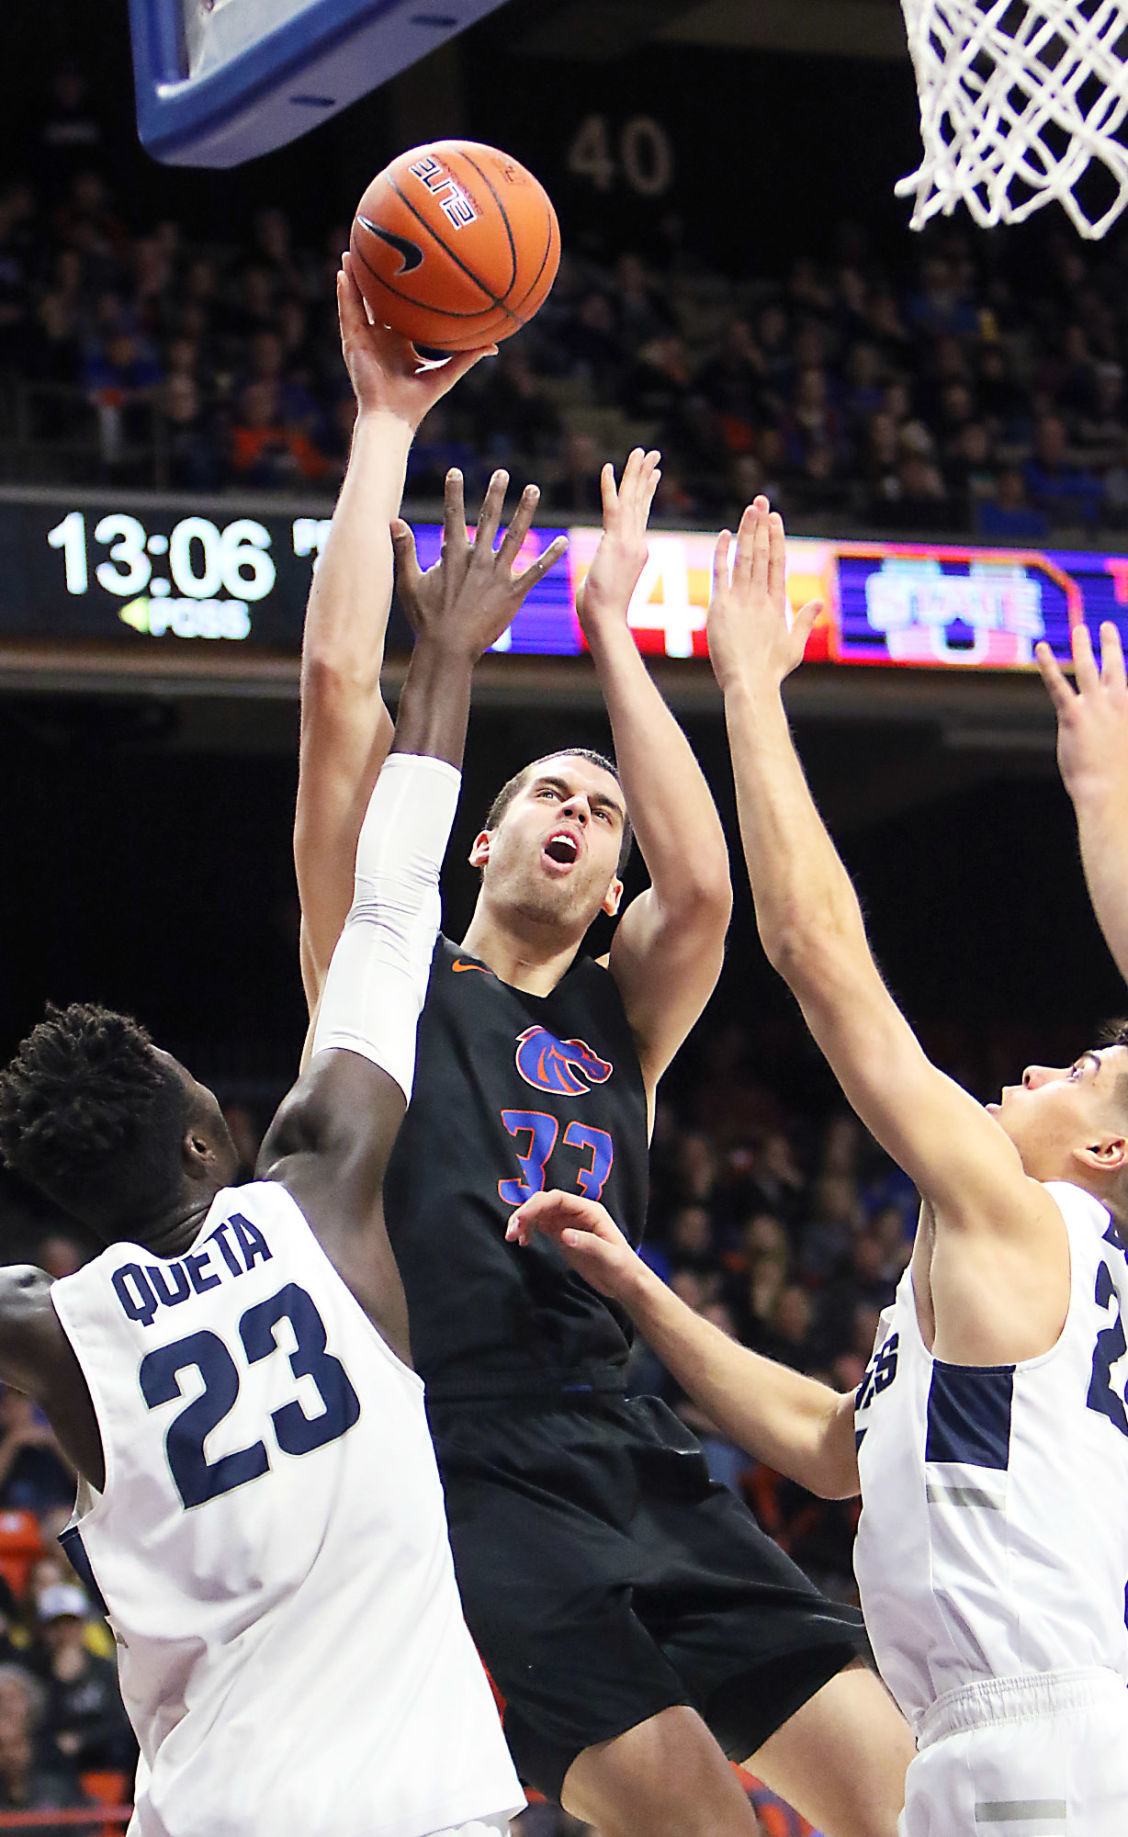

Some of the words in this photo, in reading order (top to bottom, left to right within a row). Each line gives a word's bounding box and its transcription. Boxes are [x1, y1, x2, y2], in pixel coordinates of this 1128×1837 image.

[567, 115, 672, 193] 40
[47, 511, 276, 601] 13:06
[111, 1212, 273, 1328] QUETA
[138, 1282, 361, 1513] 23
